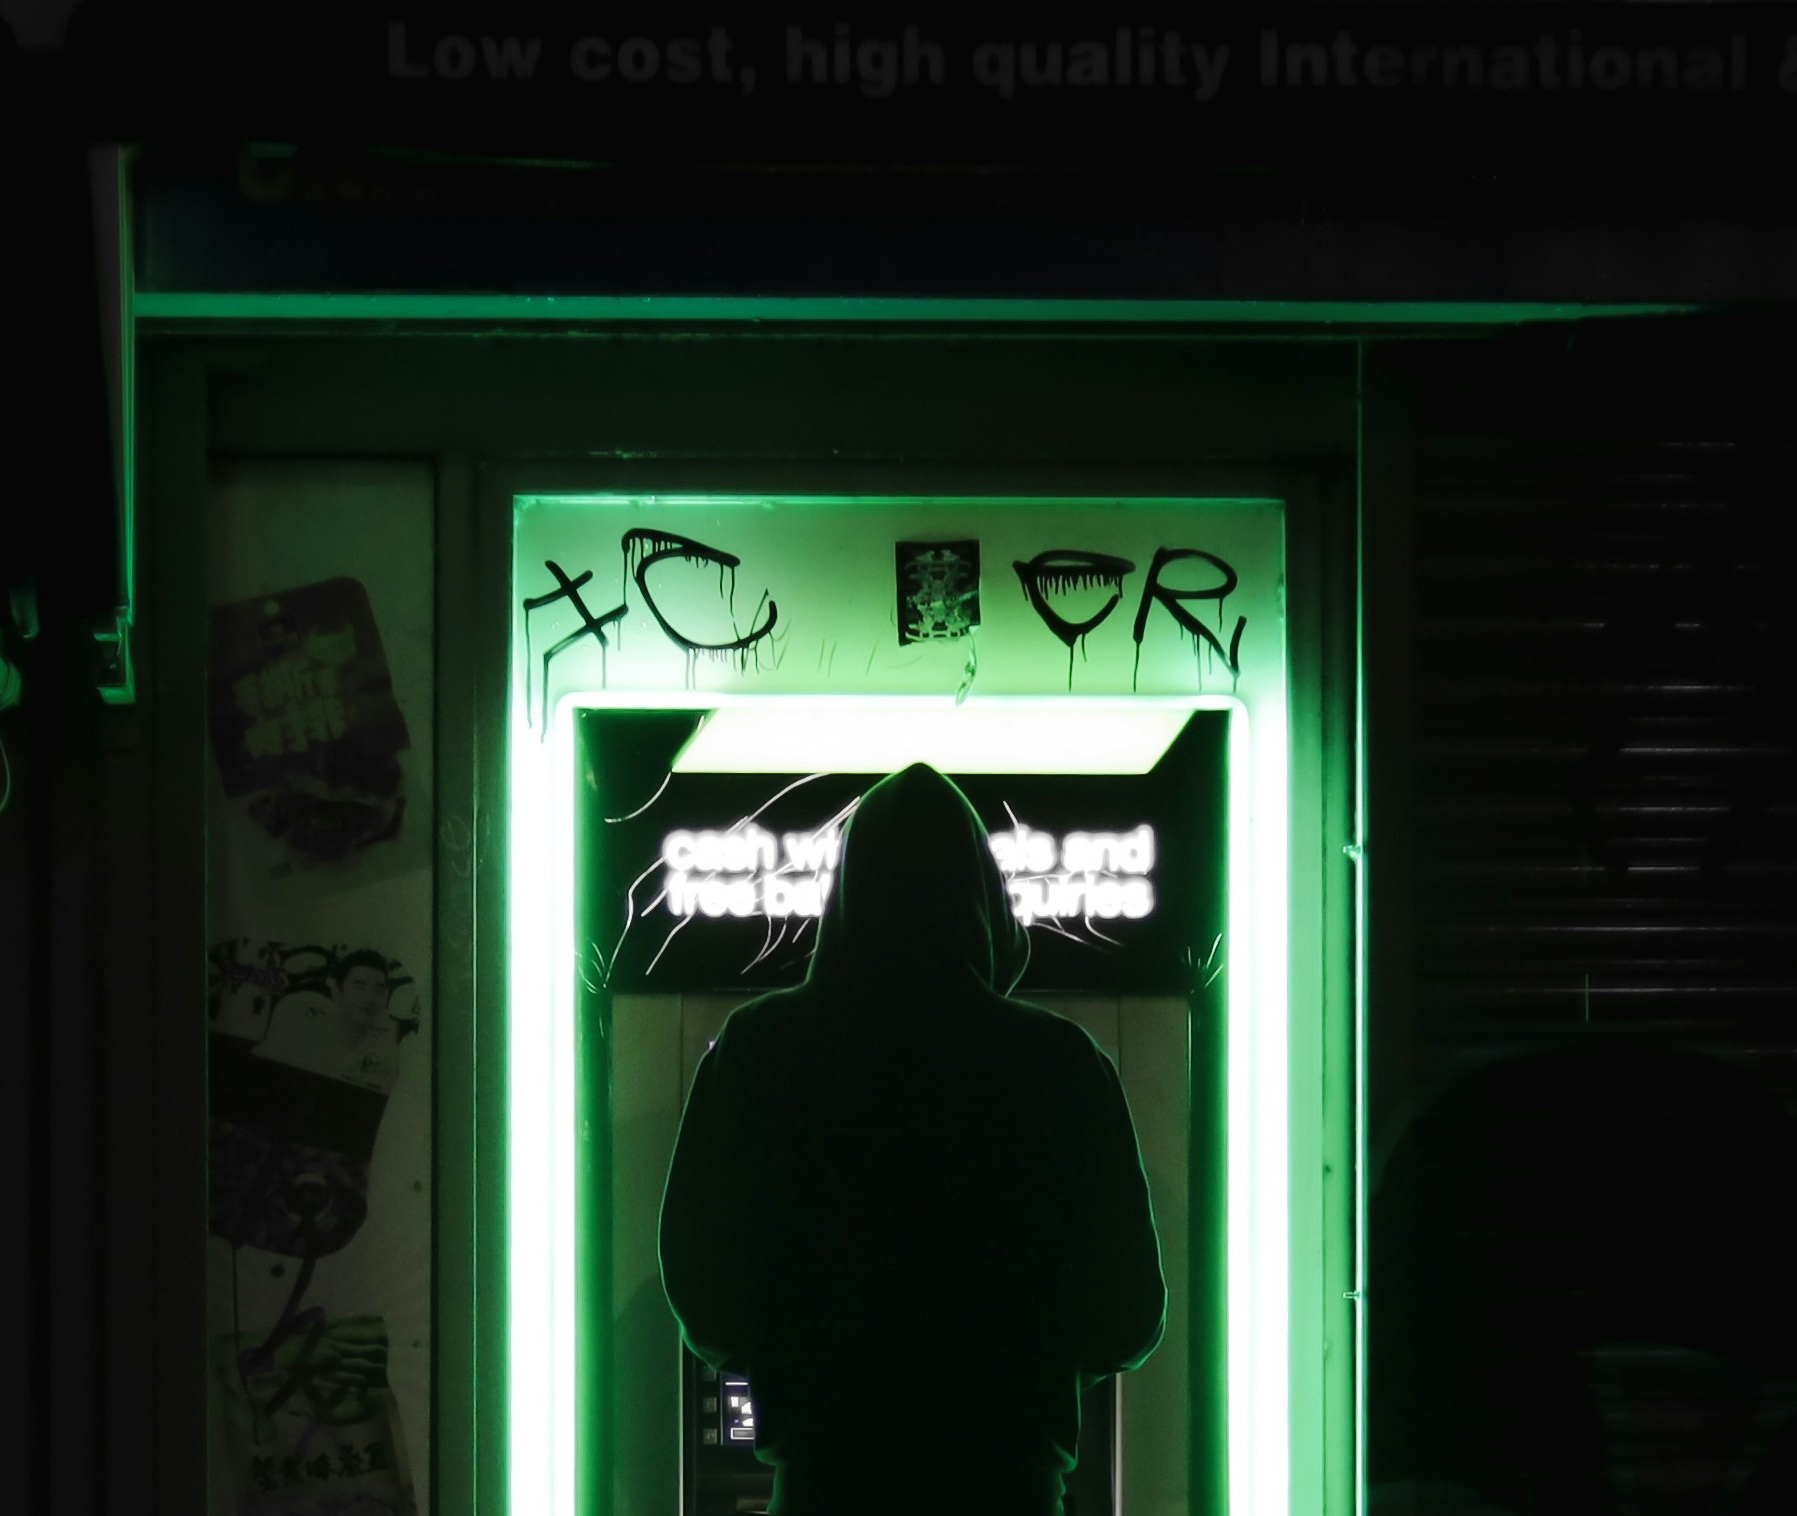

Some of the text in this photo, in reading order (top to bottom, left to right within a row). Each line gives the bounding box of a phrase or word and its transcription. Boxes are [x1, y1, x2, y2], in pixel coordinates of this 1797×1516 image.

[387, 19, 543, 82] Low
[569, 24, 757, 96] cost,
[785, 21, 946, 98] high
[972, 24, 1230, 101] quality
[1259, 27, 1747, 92] International
[664, 824, 776, 871] cash
[1063, 825, 1155, 873] and
[667, 873, 756, 917] free
